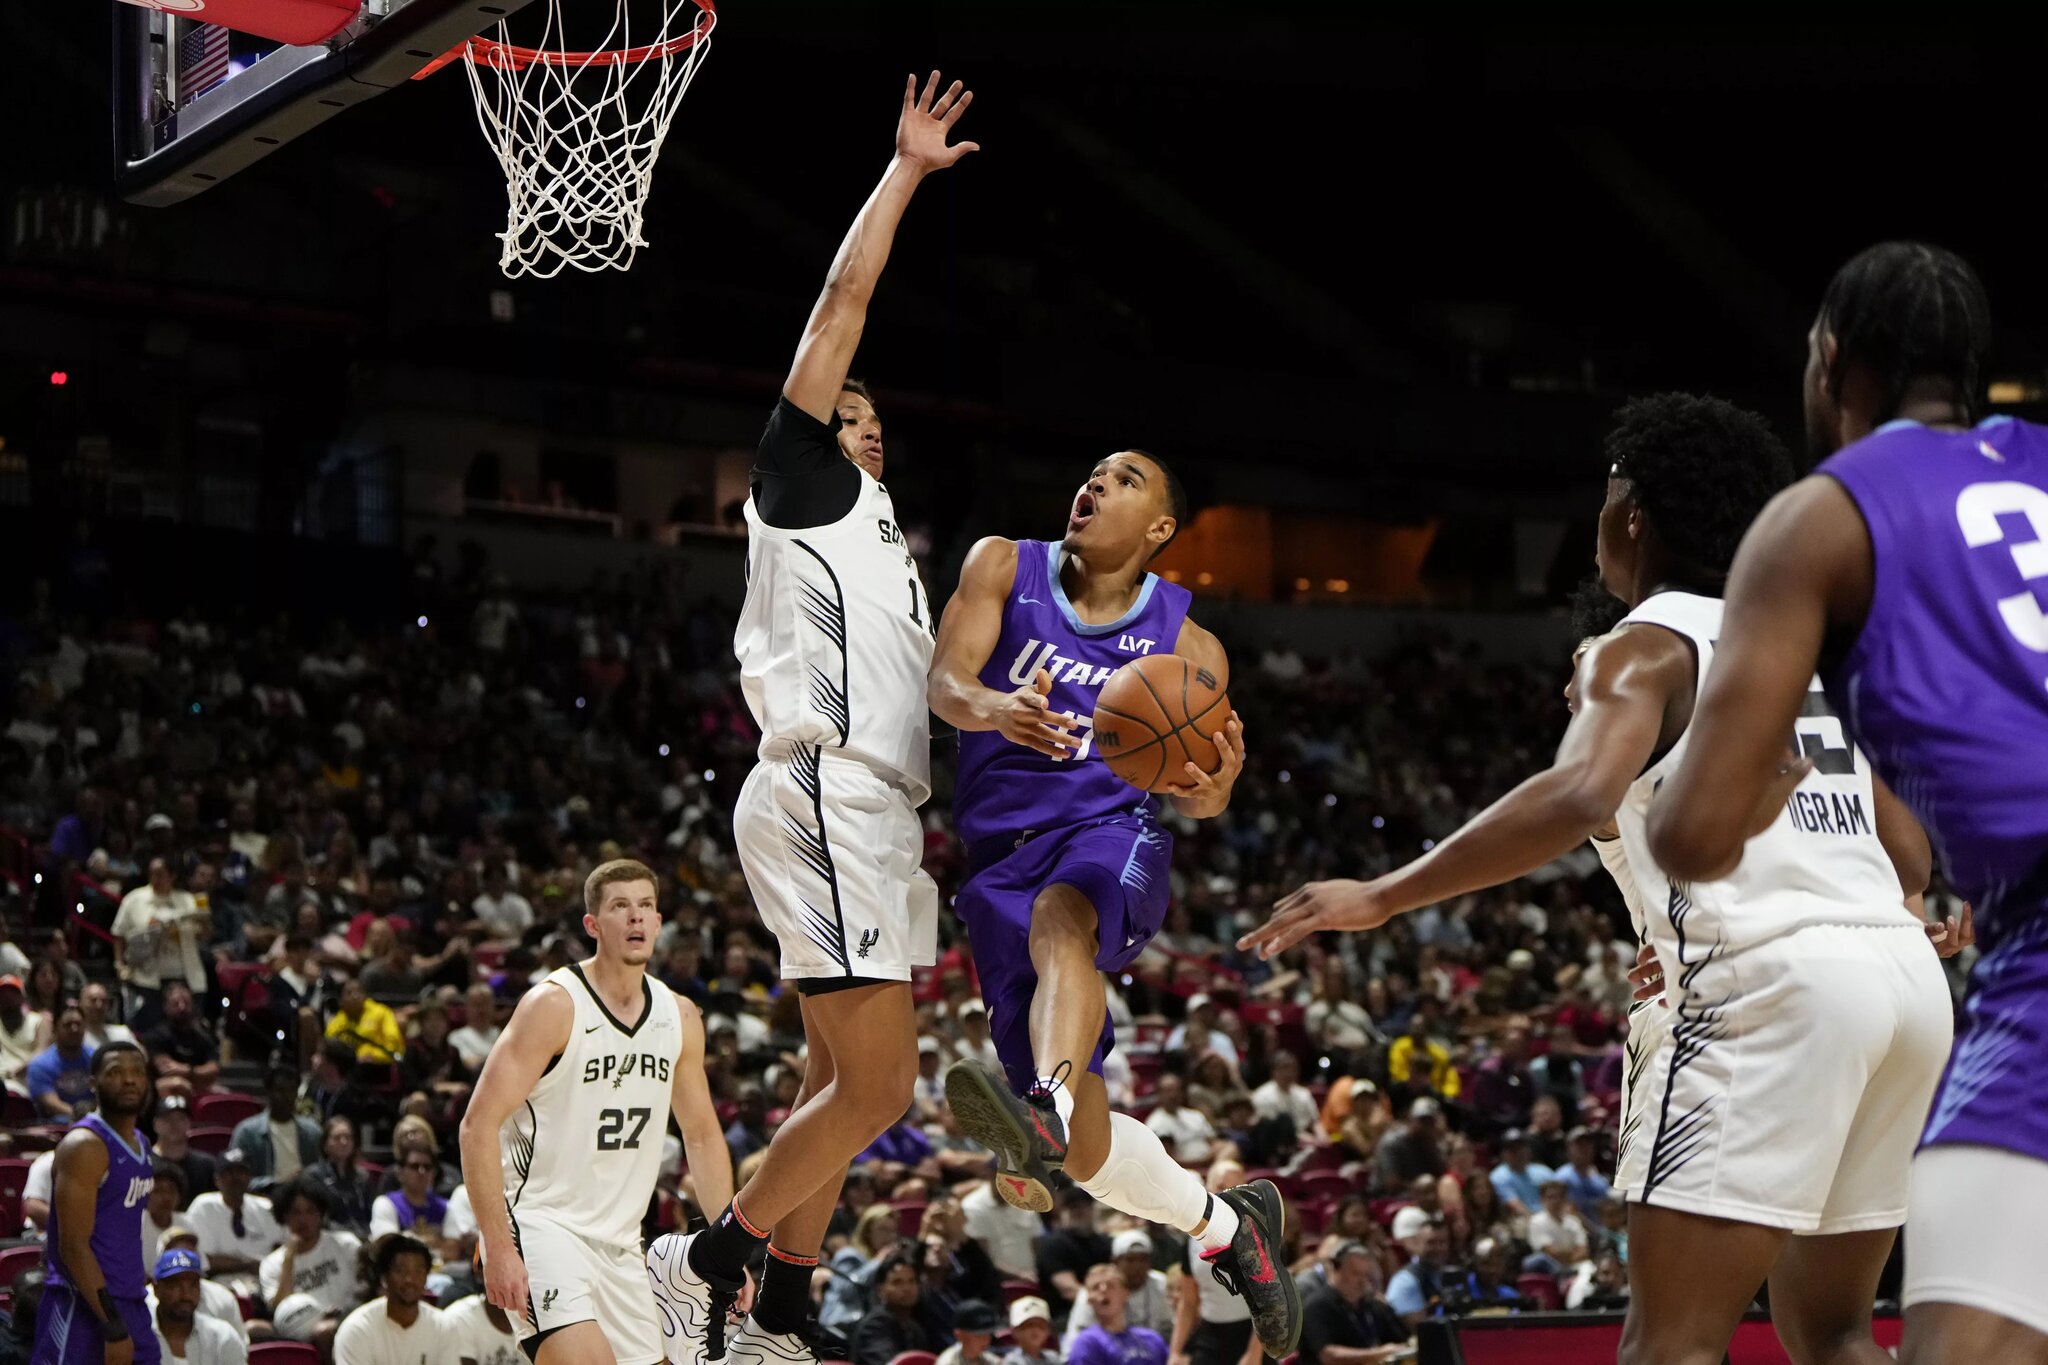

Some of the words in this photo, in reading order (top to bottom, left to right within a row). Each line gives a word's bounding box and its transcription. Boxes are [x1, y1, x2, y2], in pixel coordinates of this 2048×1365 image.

[1117, 634, 1156, 655] LVT
[583, 1053, 670, 1091] SPURS
[597, 1107, 652, 1151] 27
